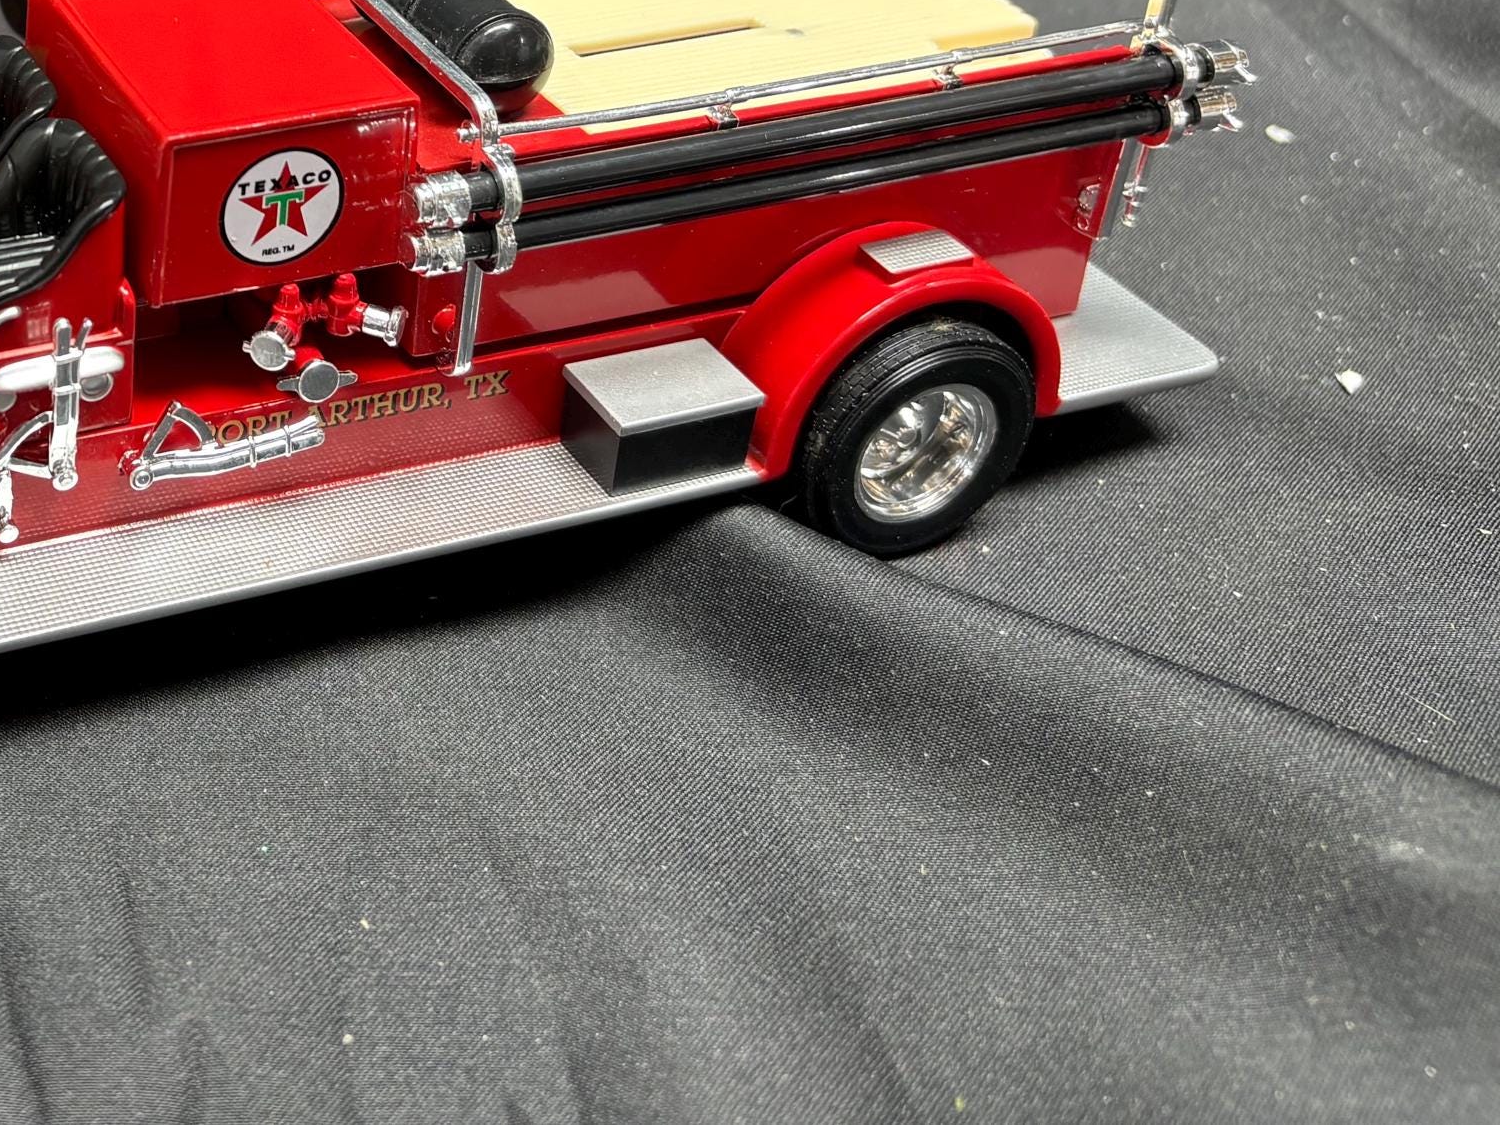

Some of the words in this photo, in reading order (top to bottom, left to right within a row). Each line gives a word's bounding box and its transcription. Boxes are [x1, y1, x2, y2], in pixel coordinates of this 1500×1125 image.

[238, 169, 333, 196] TEXACO
[261, 245, 281, 257] REG.
[282, 244, 295, 253] TM
[308, 382, 453, 428] ARTHUR,
[463, 370, 512, 401] TX
